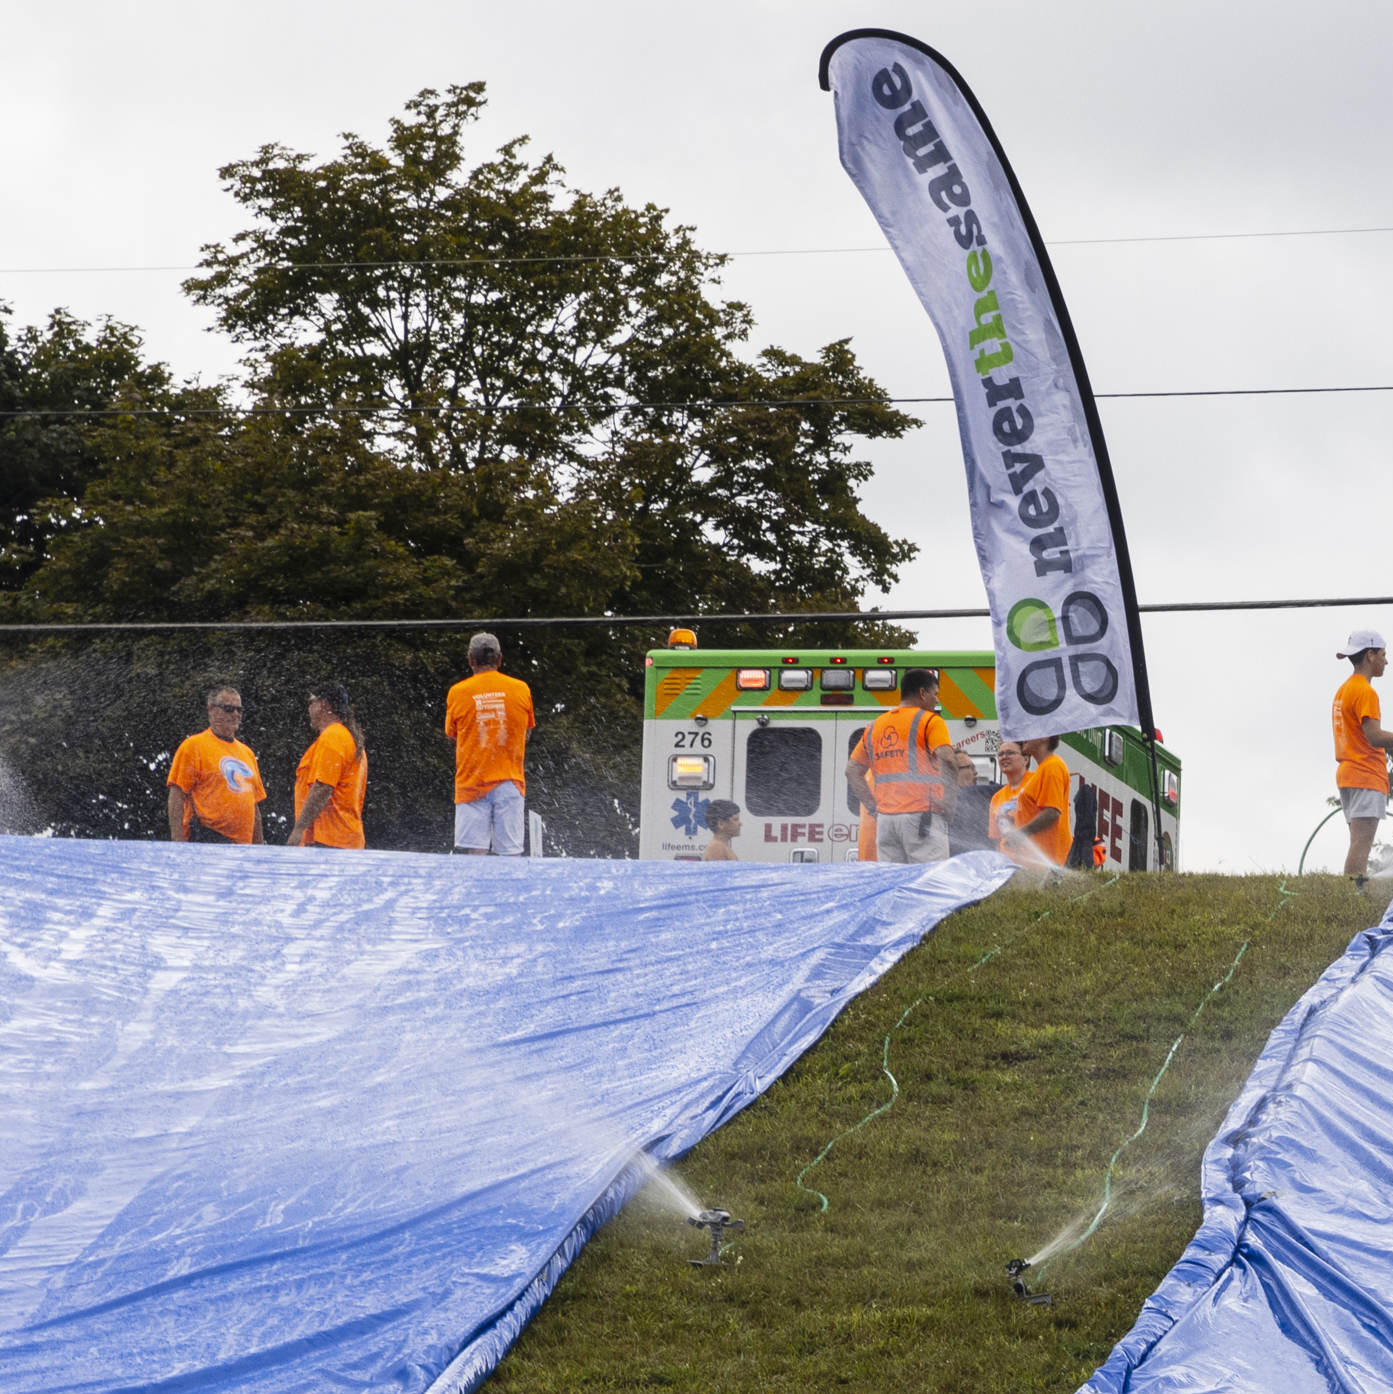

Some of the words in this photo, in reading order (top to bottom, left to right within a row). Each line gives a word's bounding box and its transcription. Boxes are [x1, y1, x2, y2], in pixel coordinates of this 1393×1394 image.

[871, 60, 1074, 578] neverthesame
[673, 731, 713, 749] 276
[875, 749, 905, 761] SAFETY
[763, 822, 825, 844] LIFE
